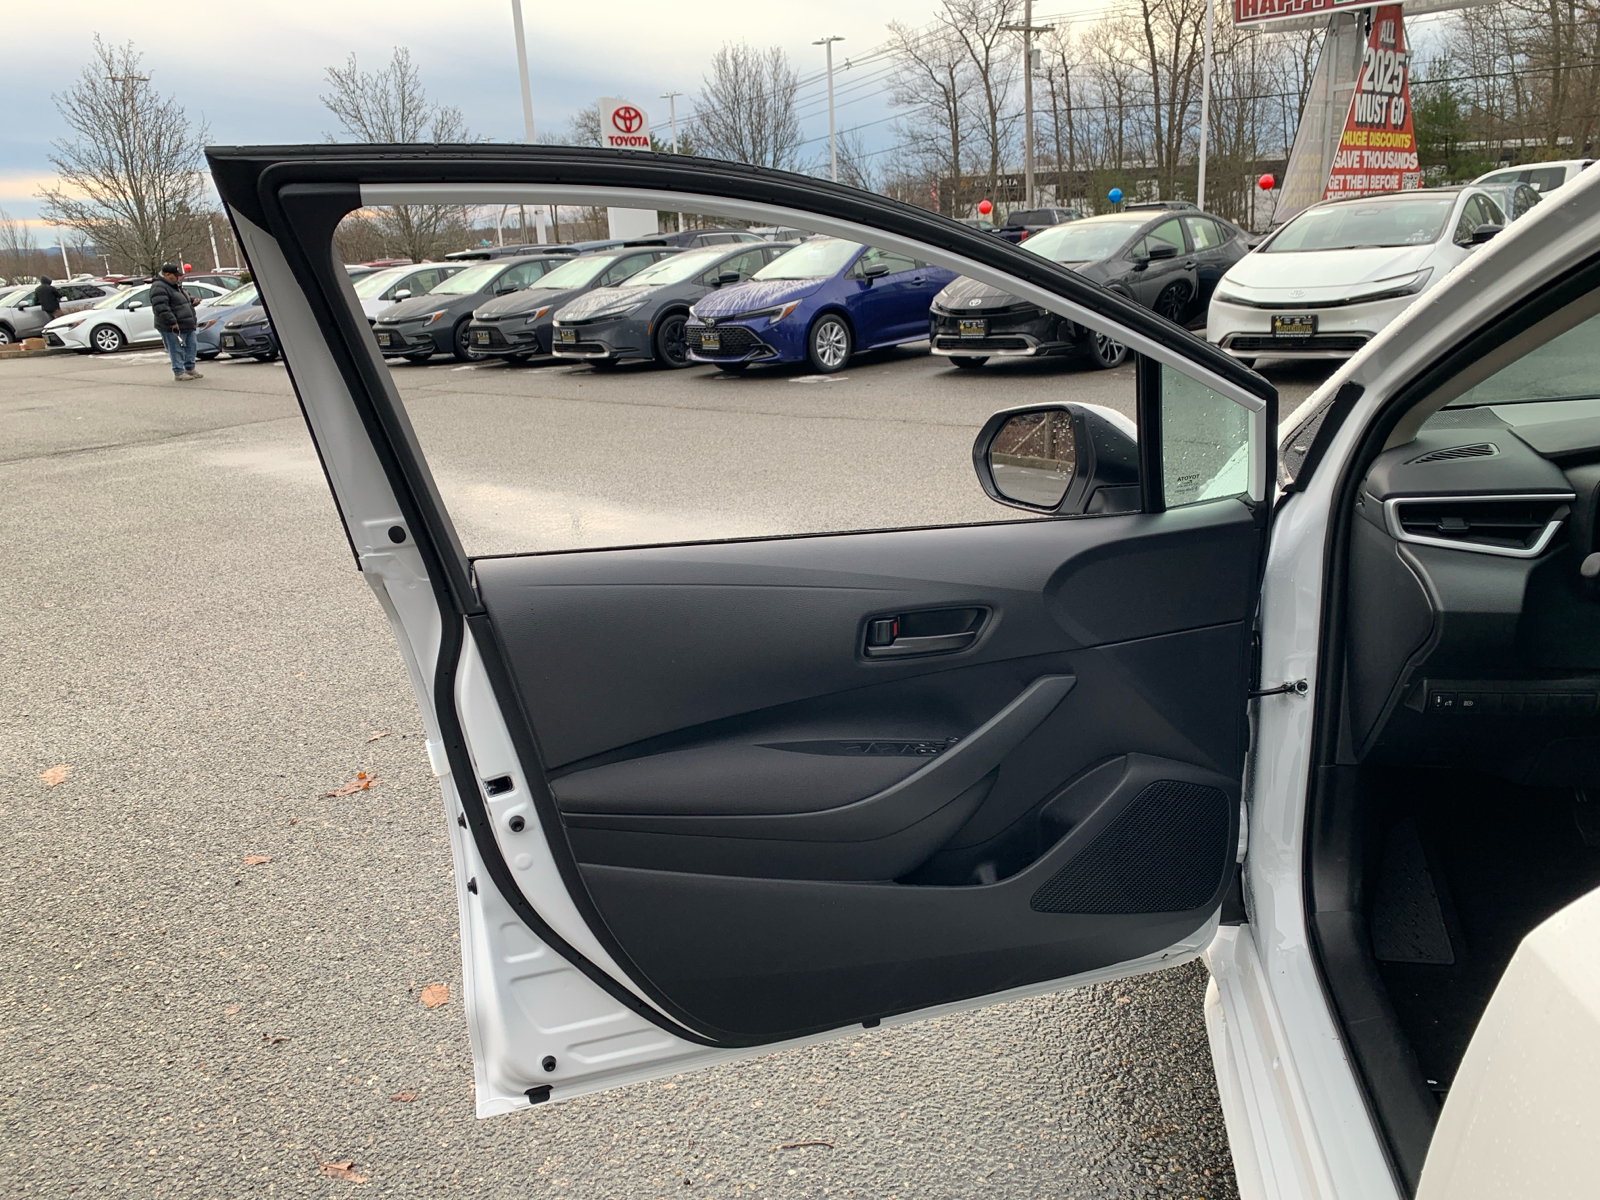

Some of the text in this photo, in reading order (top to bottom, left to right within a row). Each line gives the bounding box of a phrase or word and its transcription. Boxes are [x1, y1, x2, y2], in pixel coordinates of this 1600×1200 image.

[1380, 20, 1396, 45] ALL
[1361, 47, 1406, 95] 2025
[1354, 93, 1388, 124] MUST
[1391, 96, 1405, 126] GO
[608, 136, 649, 147] TOYOTA
[1342, 130, 1412, 149] HUGE DISCOUNTS
[1334, 150, 1418, 170] SAVE THOUSANDS
[1328, 174, 1345, 190] GET
[1345, 174, 1369, 190] THEM
[1370, 174, 1399, 190] BEFORE
